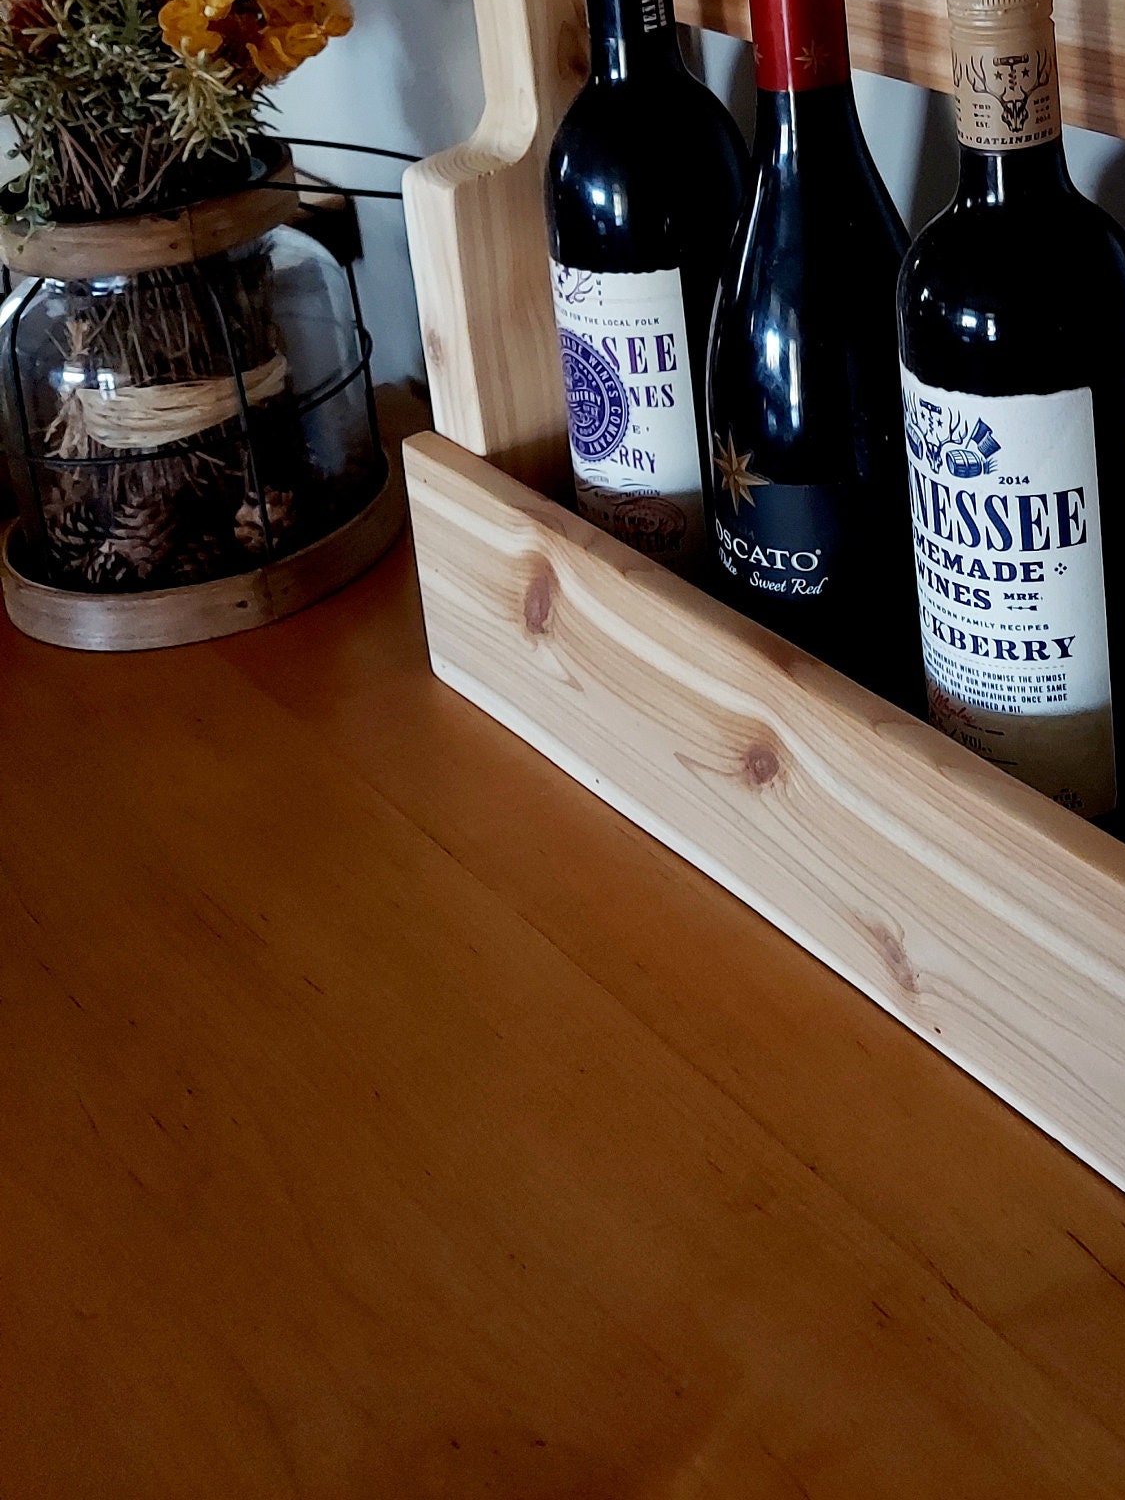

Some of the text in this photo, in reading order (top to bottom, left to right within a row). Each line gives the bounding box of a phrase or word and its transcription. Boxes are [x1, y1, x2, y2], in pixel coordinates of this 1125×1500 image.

[602, 318, 631, 327] LOCAL
[635, 317, 661, 327] FOLK
[628, 383, 675, 408] NES
[610, 444, 656, 475] RRY
[998, 475, 1030, 485] 2014
[715, 517, 820, 573] OSCATO
[749, 570, 788, 594] Sweet
[791, 576, 829, 596] Red
[916, 552, 992, 610] WINES
[920, 604, 1076, 661] CKBERRY
[961, 616, 995, 630] FAMILY
[1000, 623, 1050, 632] RECIPES
[965, 676, 979, 686] OUR
[981, 681, 1004, 692] WINES
[1006, 685, 1026, 694] WITH
[1029, 685, 1043, 693] THE
[1046, 683, 1068, 692] SAME
[982, 671, 1015, 683] PROMISE
[1018, 675, 1033, 683] THE
[1035, 673, 1066, 683] UTMOST
[964, 685, 1017, 703] GRANDFATHERS
[1021, 695, 1042, 703] ONCE
[1046, 693, 1068, 703] MADE
[968, 696, 999, 711] CHANGED
